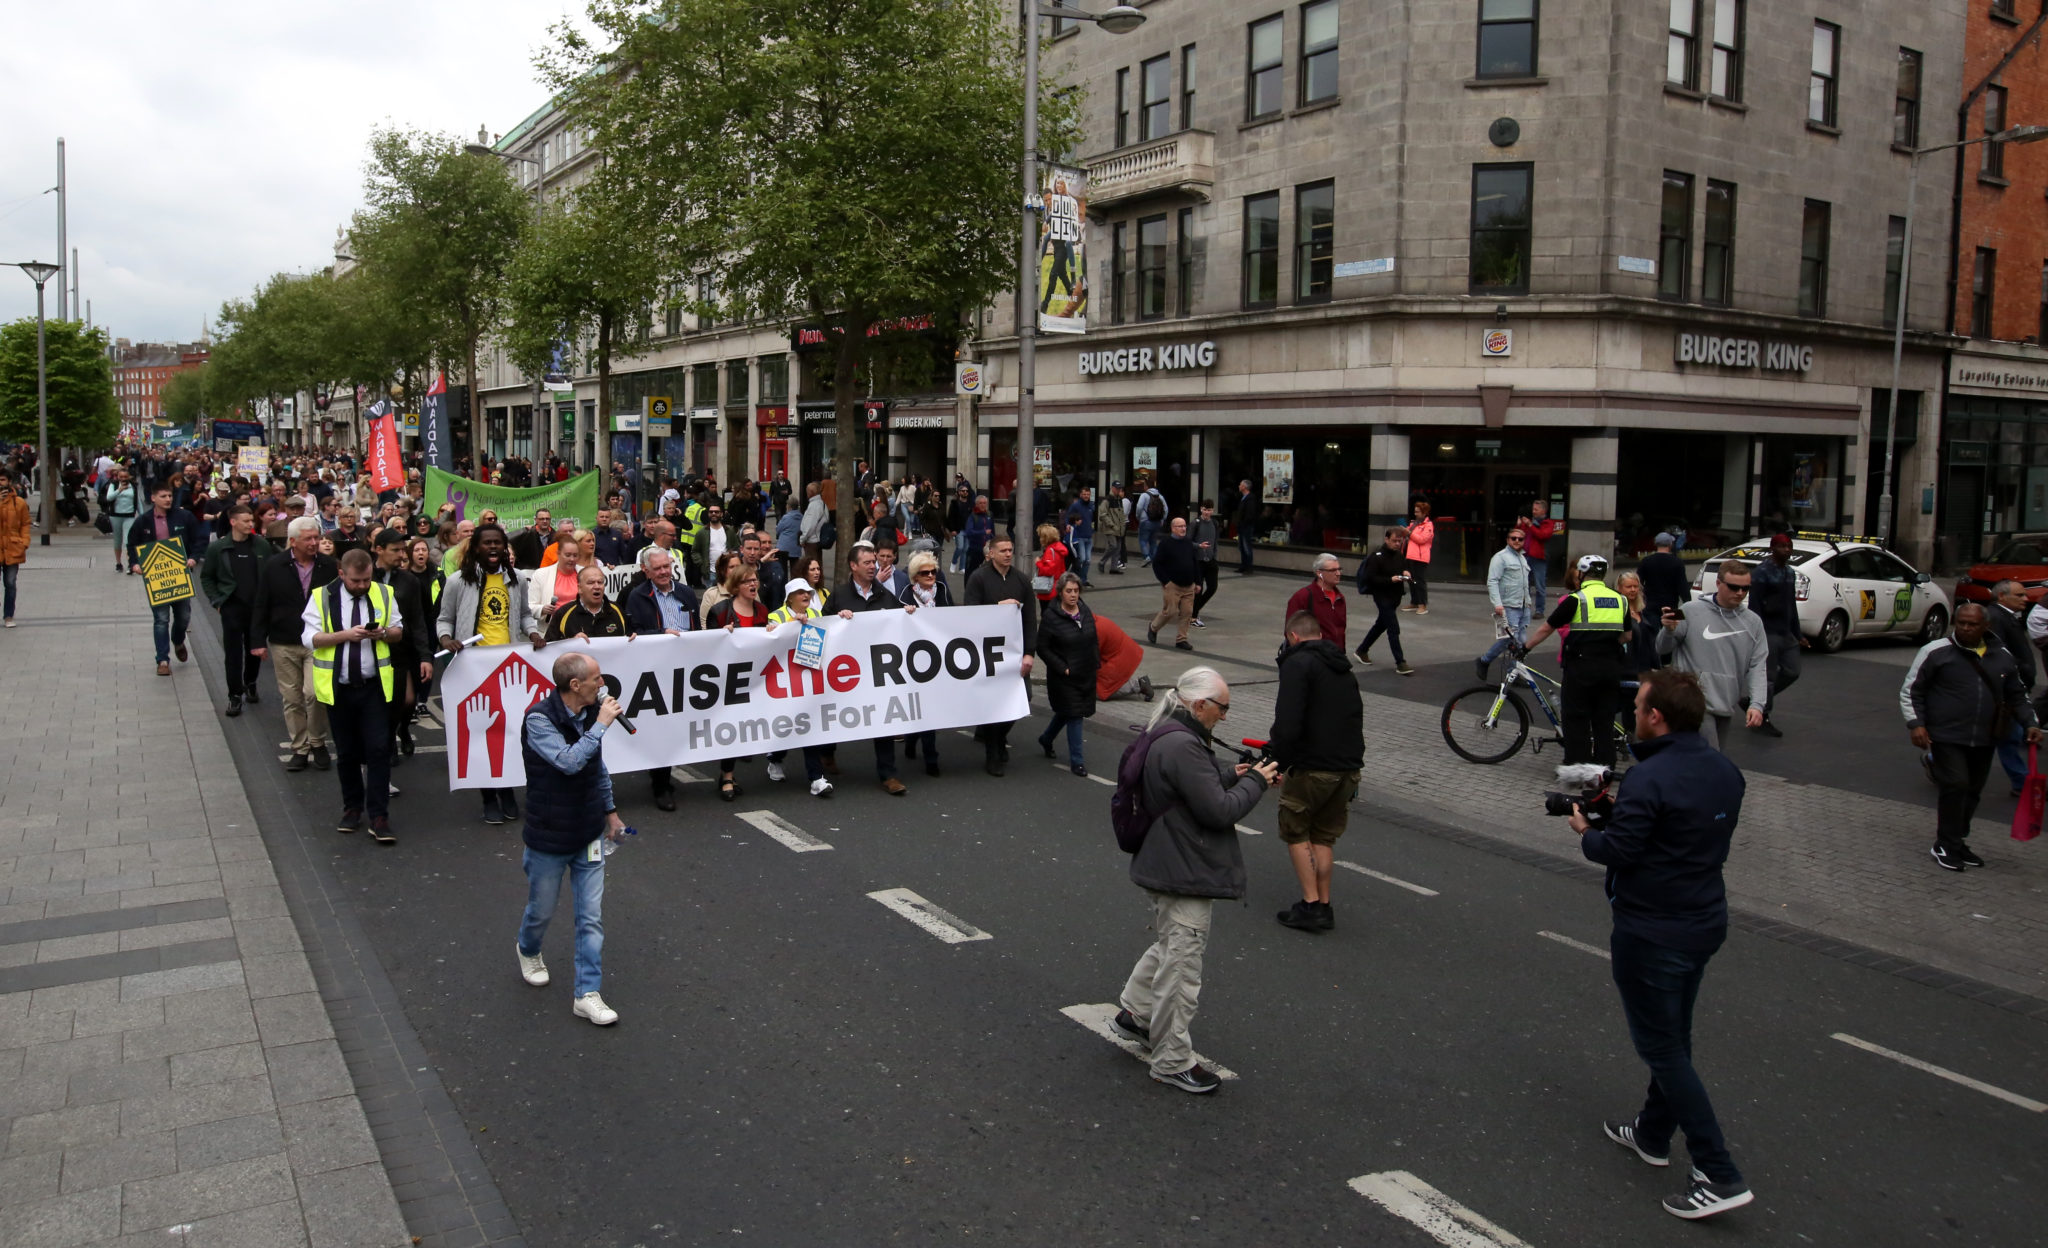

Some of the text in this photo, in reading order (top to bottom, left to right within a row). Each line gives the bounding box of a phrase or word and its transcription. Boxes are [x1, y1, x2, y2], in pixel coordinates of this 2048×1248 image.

[1488, 339, 1508, 349] KING
[1078, 341, 1215, 375] BURGER KING
[1680, 333, 1814, 372] BURGER KING
[962, 376, 979, 385] KING
[895, 417, 942, 428] BURGER KING
[154, 560, 173, 571] RENT
[149, 567, 184, 582] CONTROL
[160, 578, 177, 588] NOW
[154, 592, 171, 601] Sinn
[1896, 599, 1912, 611] TAXI
[760, 648, 861, 699] the
[870, 636, 1006, 688] ROOF
[689, 691, 922, 750] Homes For All
